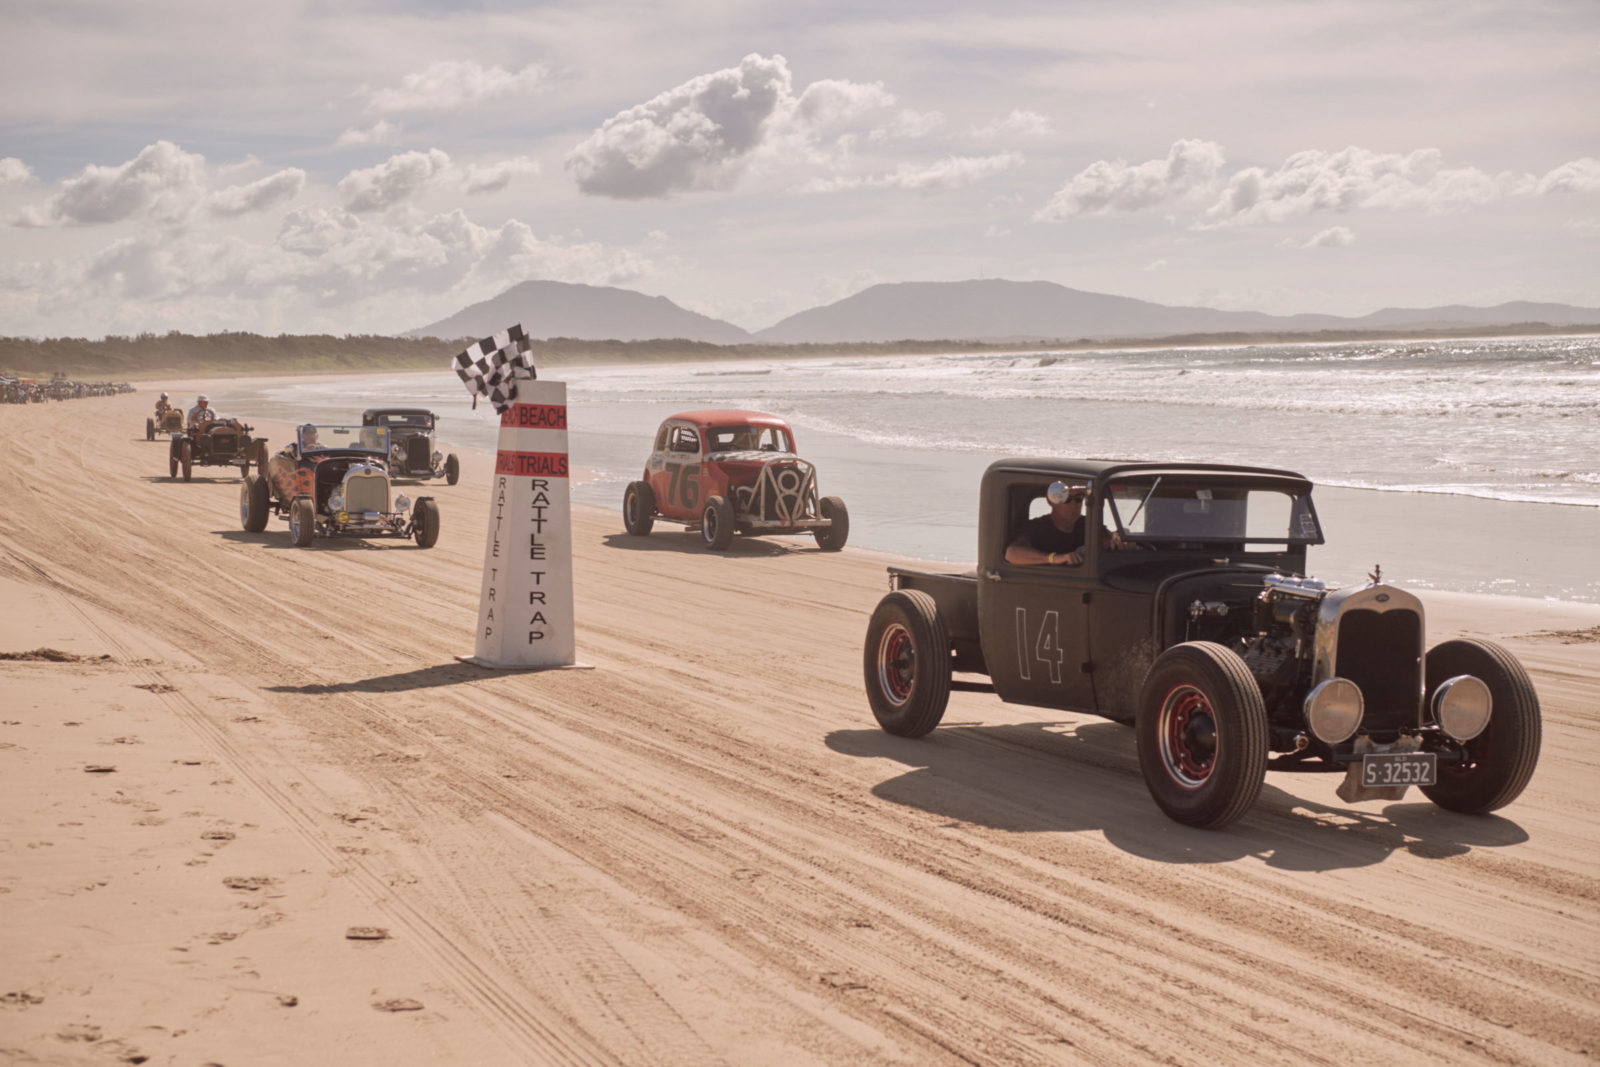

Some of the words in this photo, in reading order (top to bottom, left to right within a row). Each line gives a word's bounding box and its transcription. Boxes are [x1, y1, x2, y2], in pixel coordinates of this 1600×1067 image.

[520, 406, 566, 427] BEACH
[518, 455, 567, 475] TRIALS
[665, 462, 702, 510] 76
[492, 477, 507, 558] RATTLE
[530, 479, 550, 560] RATTLE
[485, 568, 498, 639] TRAP
[528, 571, 547, 645] TRAP
[1016, 607, 1064, 684] 14
